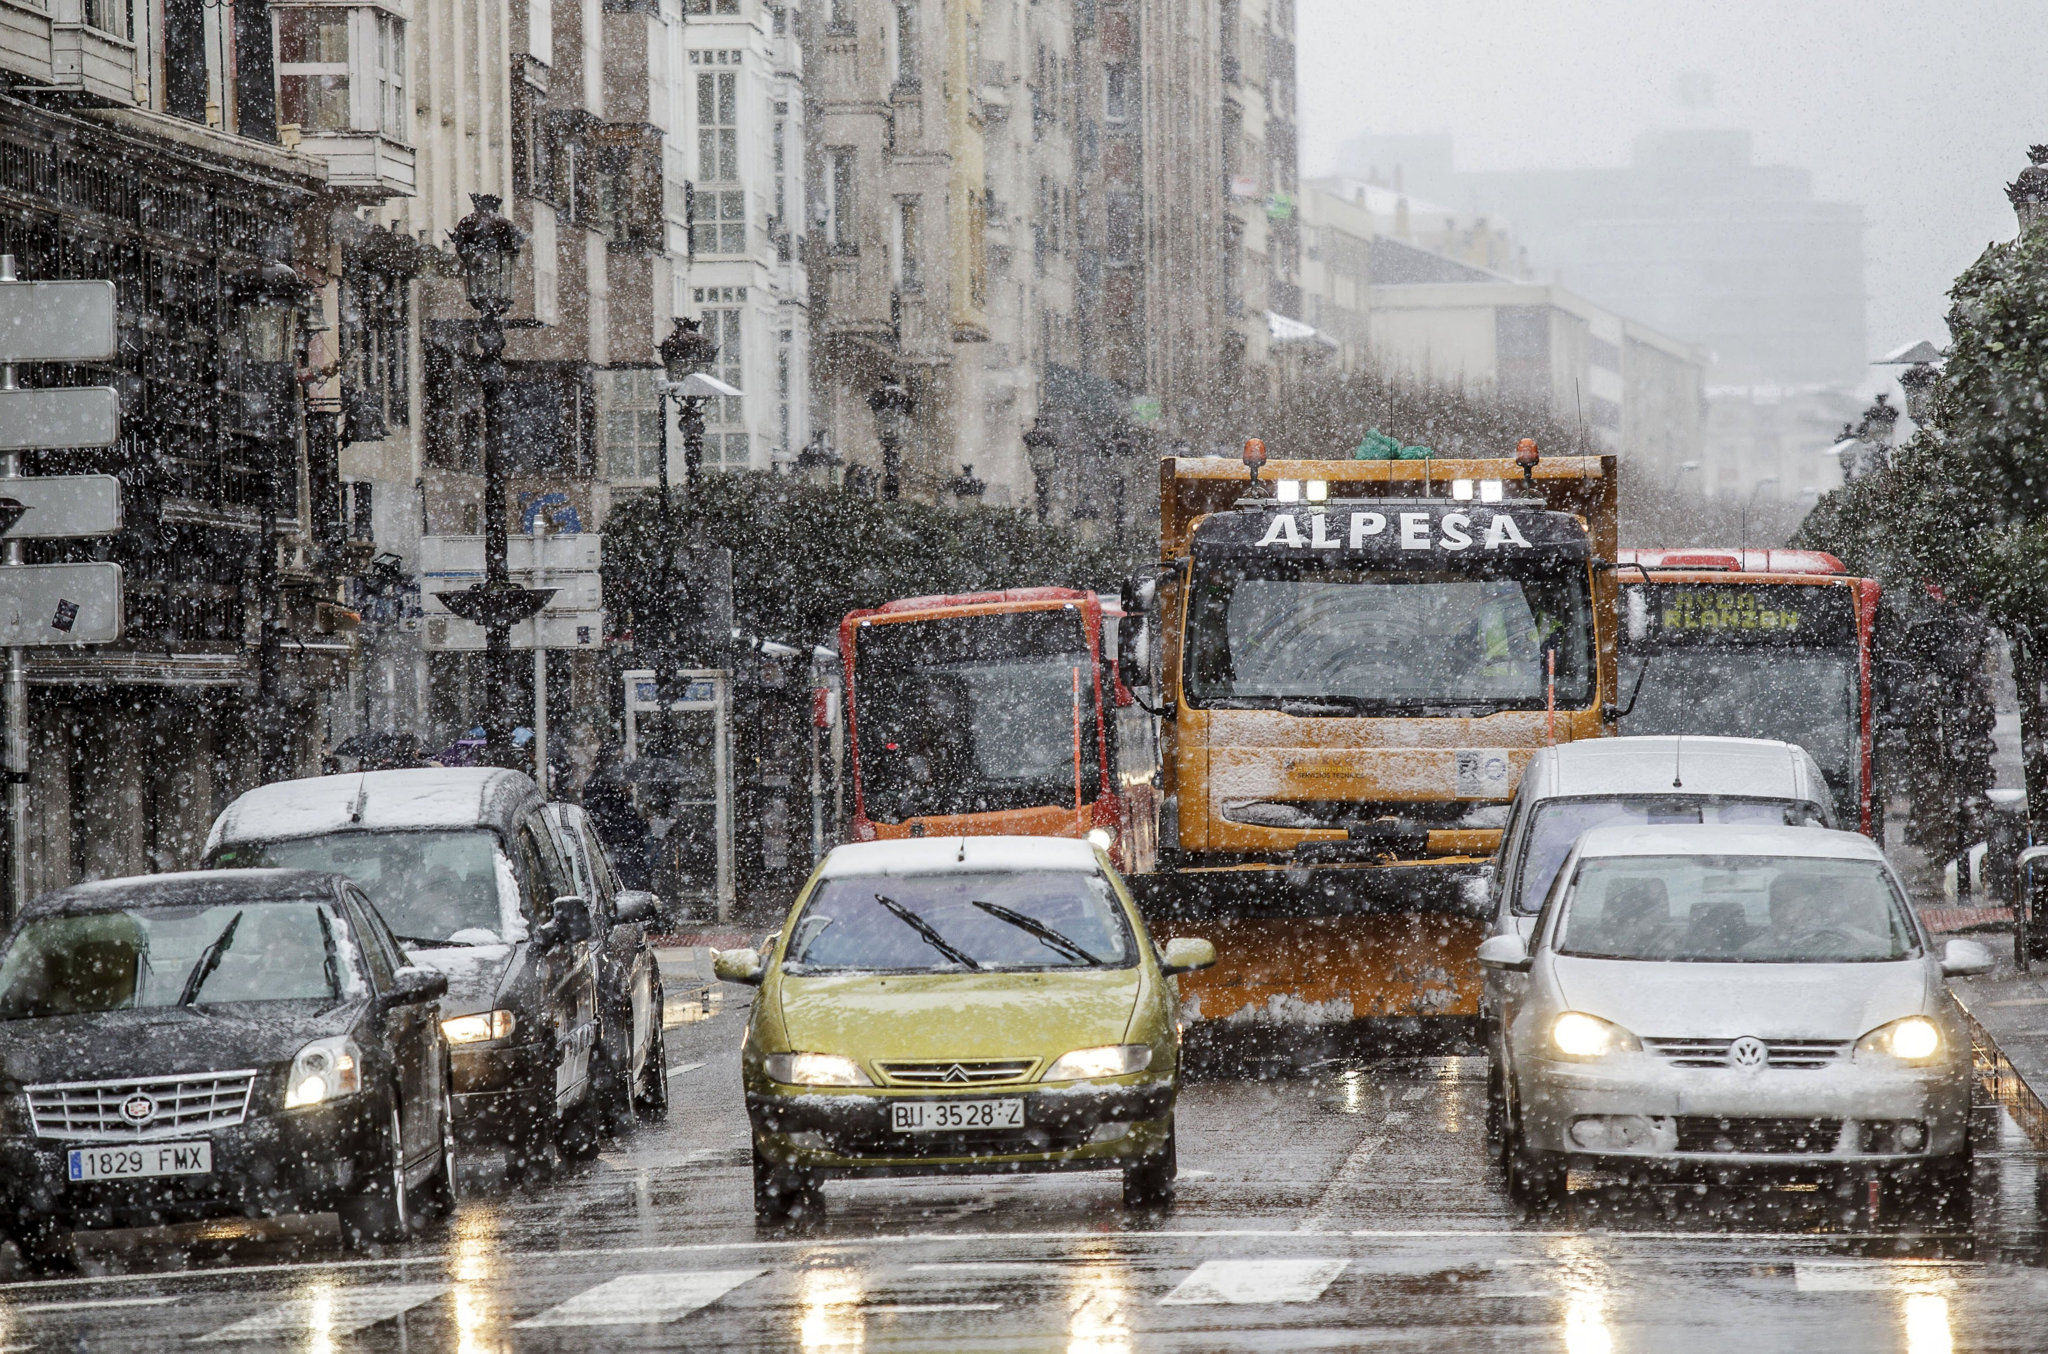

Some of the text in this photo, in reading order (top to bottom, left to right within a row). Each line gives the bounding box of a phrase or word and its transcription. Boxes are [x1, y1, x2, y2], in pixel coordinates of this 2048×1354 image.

[1254, 512, 1533, 551] ALPESA
[88, 1151, 143, 1176] 1829
[159, 1147, 203, 1171] FMX
